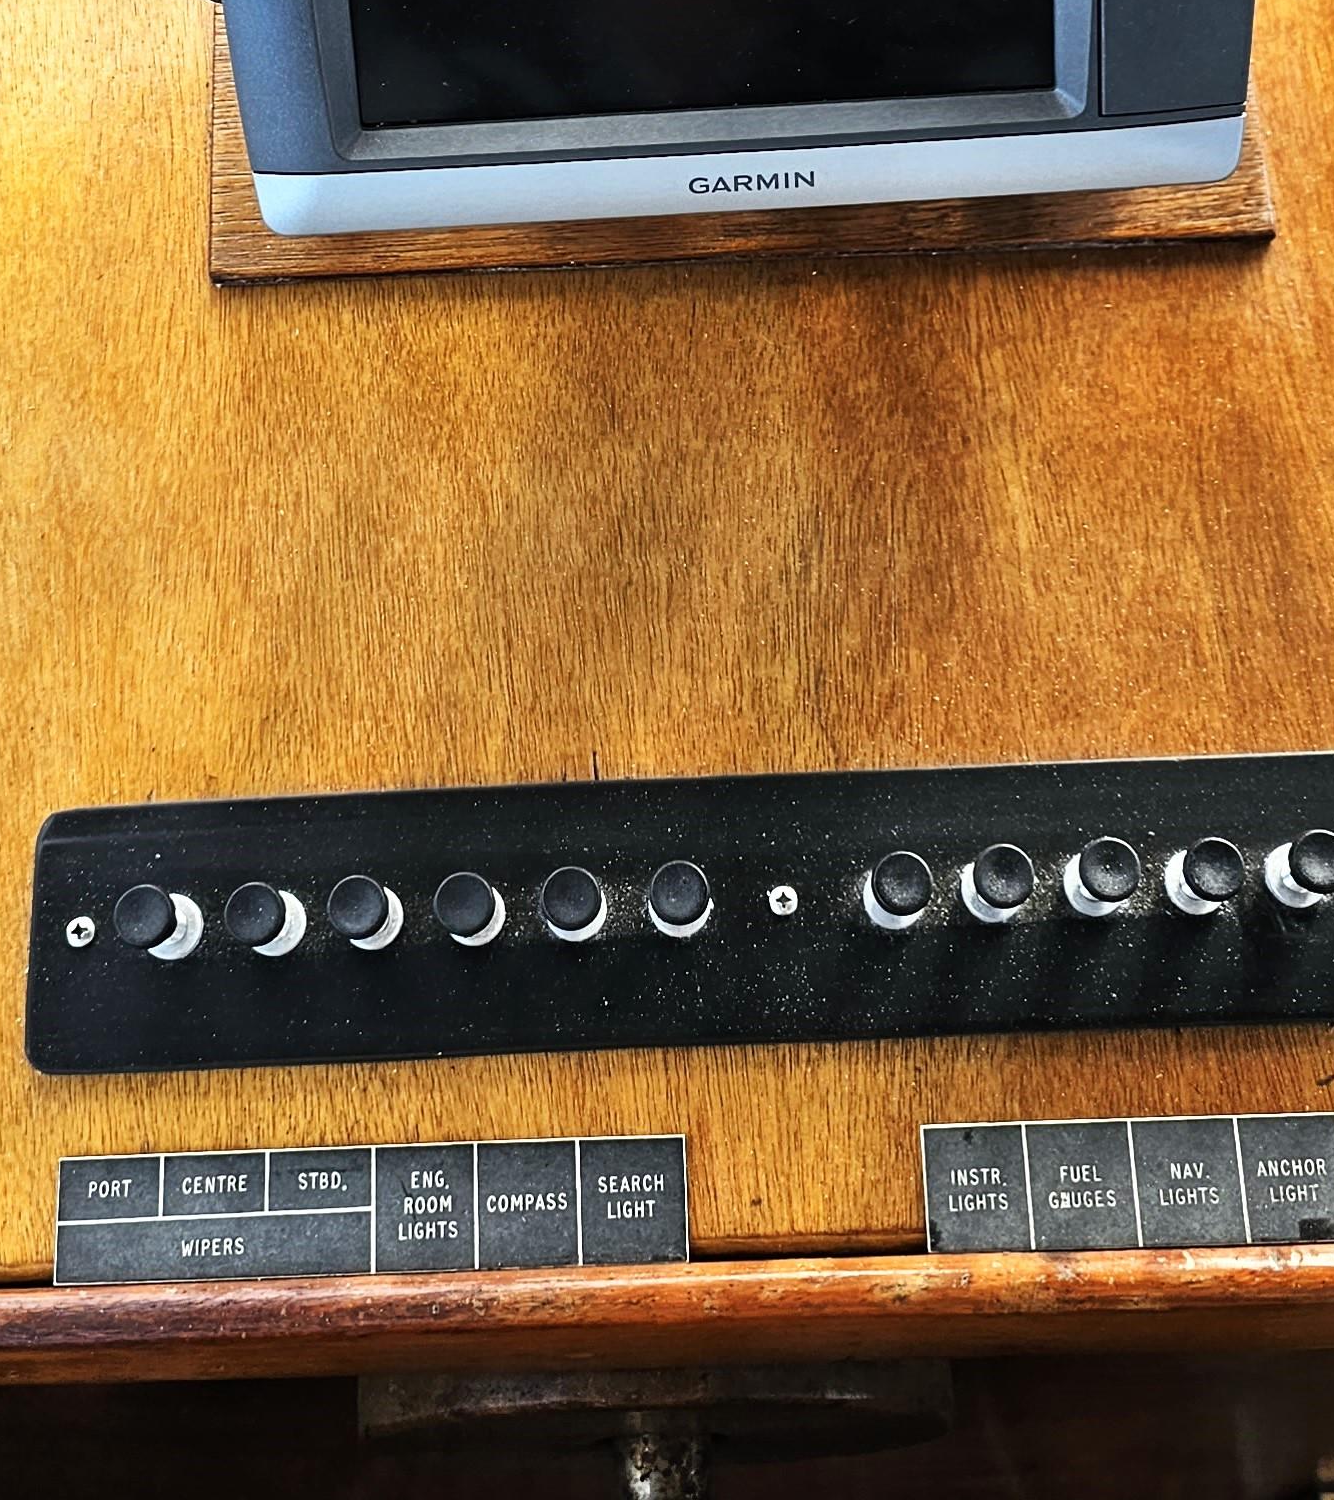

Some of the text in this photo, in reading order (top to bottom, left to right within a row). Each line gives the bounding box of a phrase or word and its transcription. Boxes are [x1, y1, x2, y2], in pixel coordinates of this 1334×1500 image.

[688, 170, 816, 194] GARMIN
[950, 1167, 1008, 1187] INSTR.
[1059, 1165, 1102, 1183] FUEL
[1170, 1162, 1211, 1180] NAV.
[1257, 1158, 1327, 1178] ANCHOR
[87, 1179, 133, 1198] PORT
[182, 1174, 249, 1195] CENTRE
[298, 1171, 348, 1191] STBD.
[410, 1170, 450, 1190] ENG.
[598, 1173, 665, 1193] SEARCH
[486, 1192, 568, 1213] COMPASS
[948, 1193, 1009, 1212] LIGHTS
[1048, 1189, 1117, 1209] GAUGES
[1159, 1186, 1220, 1206] LIGHTS
[1269, 1183, 1320, 1203] LIGHT
[403, 1195, 452, 1215] ROOM
[607, 1200, 656, 1219] LIGHT
[398, 1220, 459, 1241] LIGHTS
[181, 1237, 245, 1257] WIPERS
